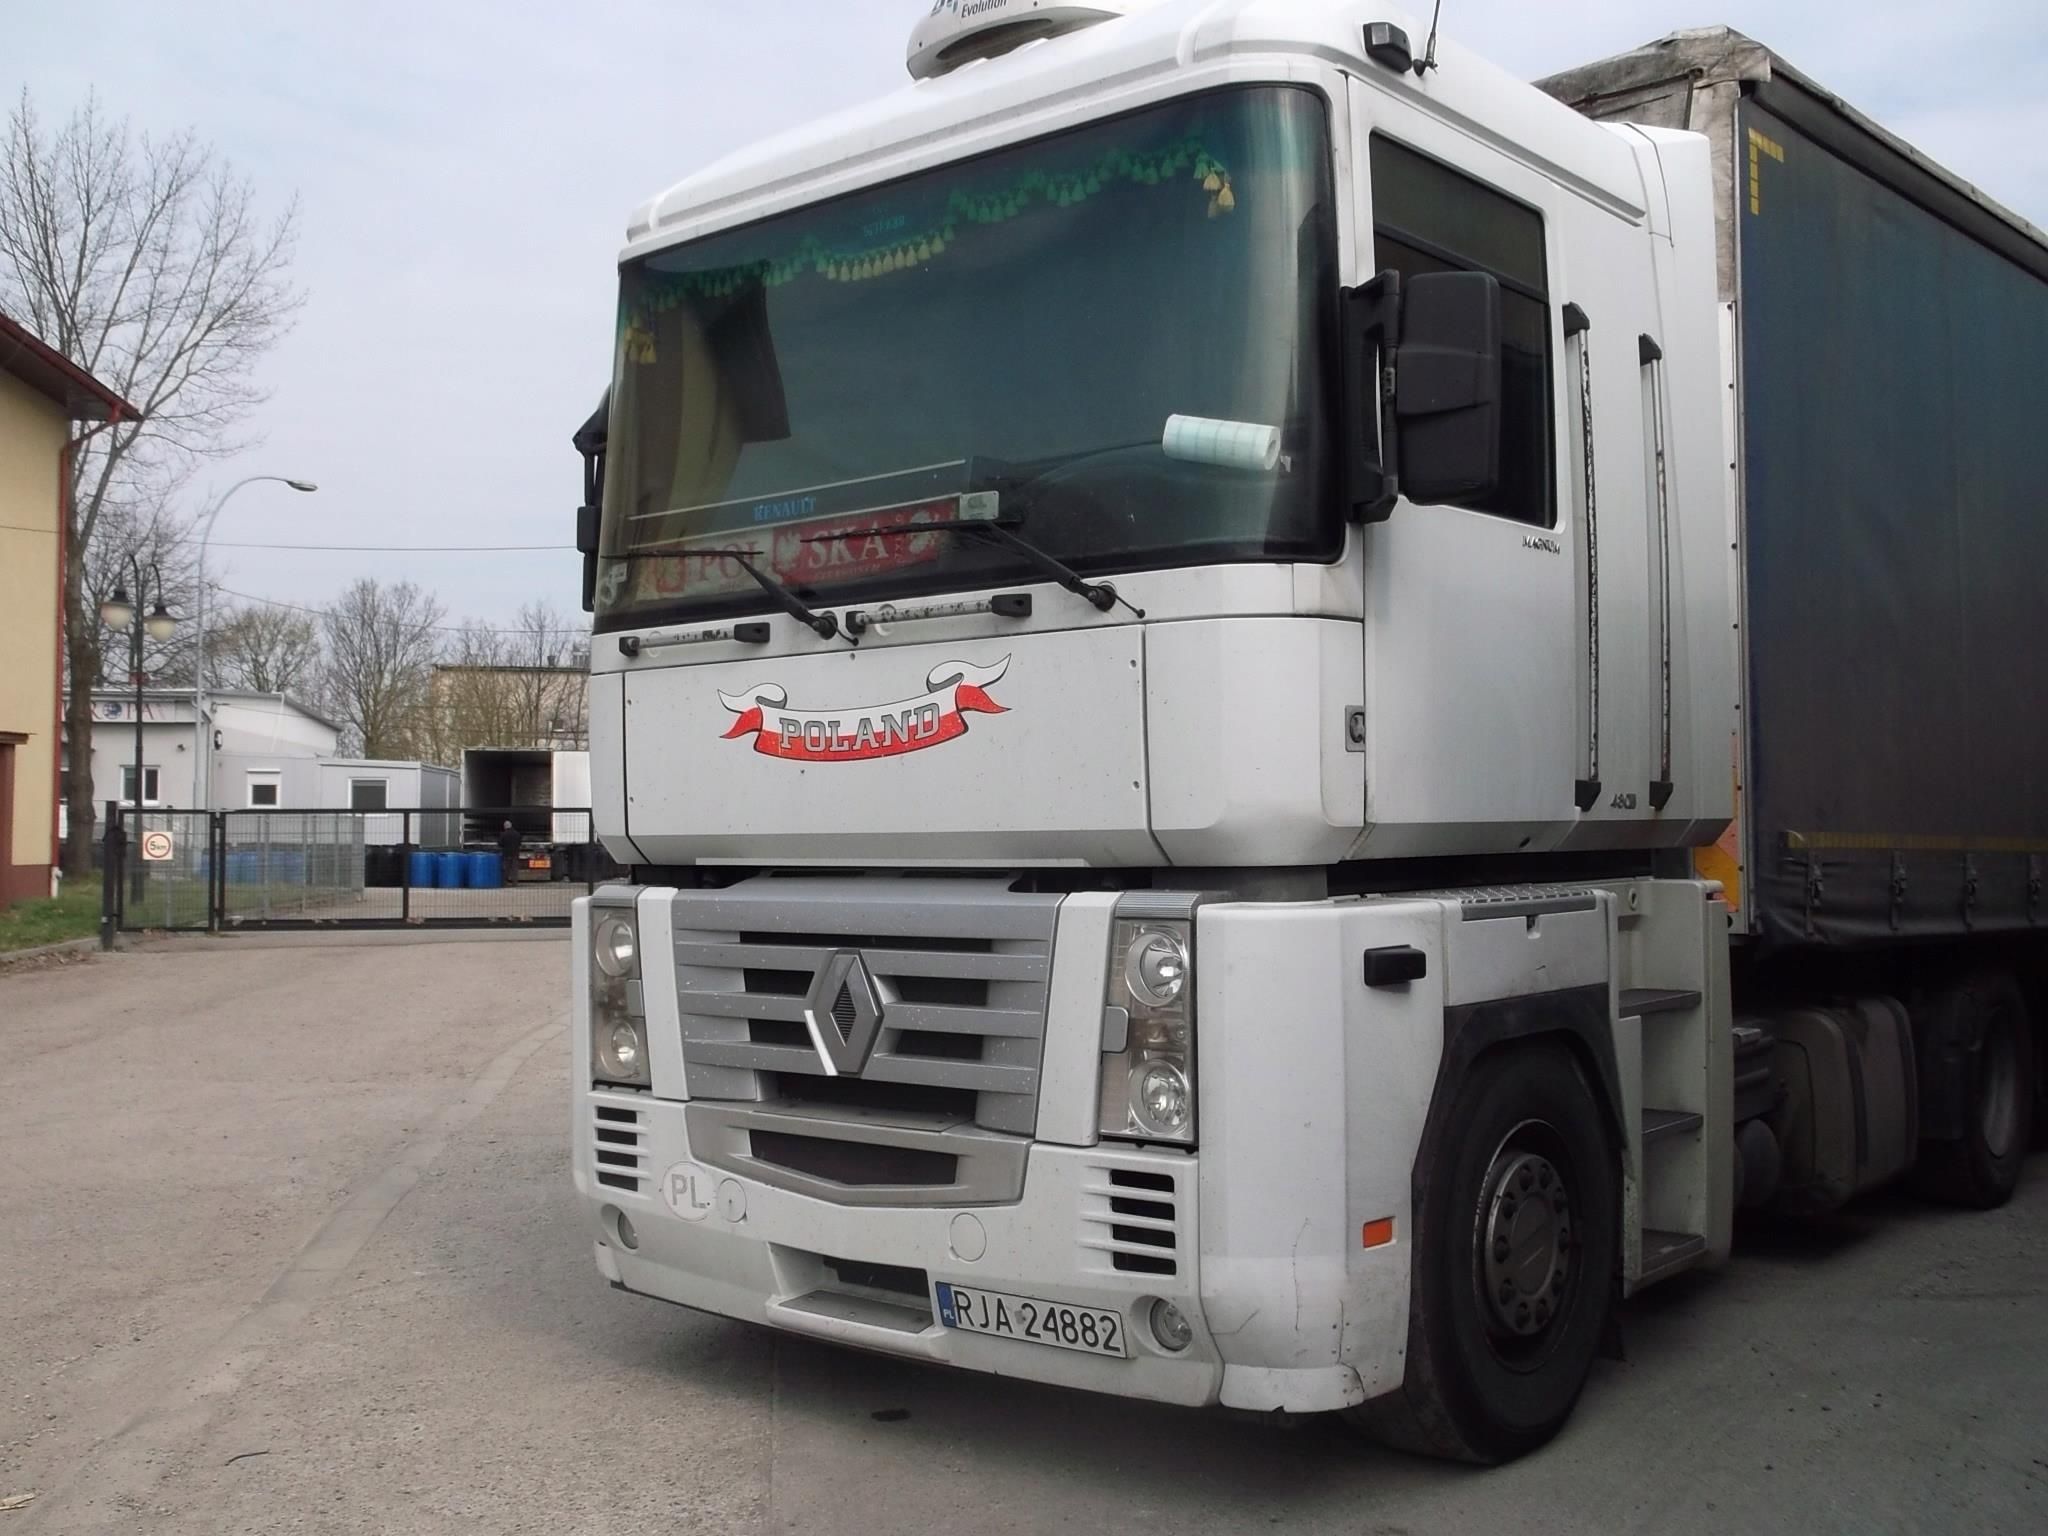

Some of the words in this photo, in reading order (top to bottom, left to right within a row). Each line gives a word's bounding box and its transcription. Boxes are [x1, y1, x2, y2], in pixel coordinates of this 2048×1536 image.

[961, 0, 1007, 18] Evolution
[754, 496, 816, 521] RENAULT
[1522, 535, 1560, 554] MAGNUM
[779, 702, 940, 752] POLAND
[671, 1173, 707, 1209] PL
[943, 1308, 955, 1320] PL
[954, 1290, 1013, 1334] RJA
[1021, 1302, 1121, 1352] 24882
